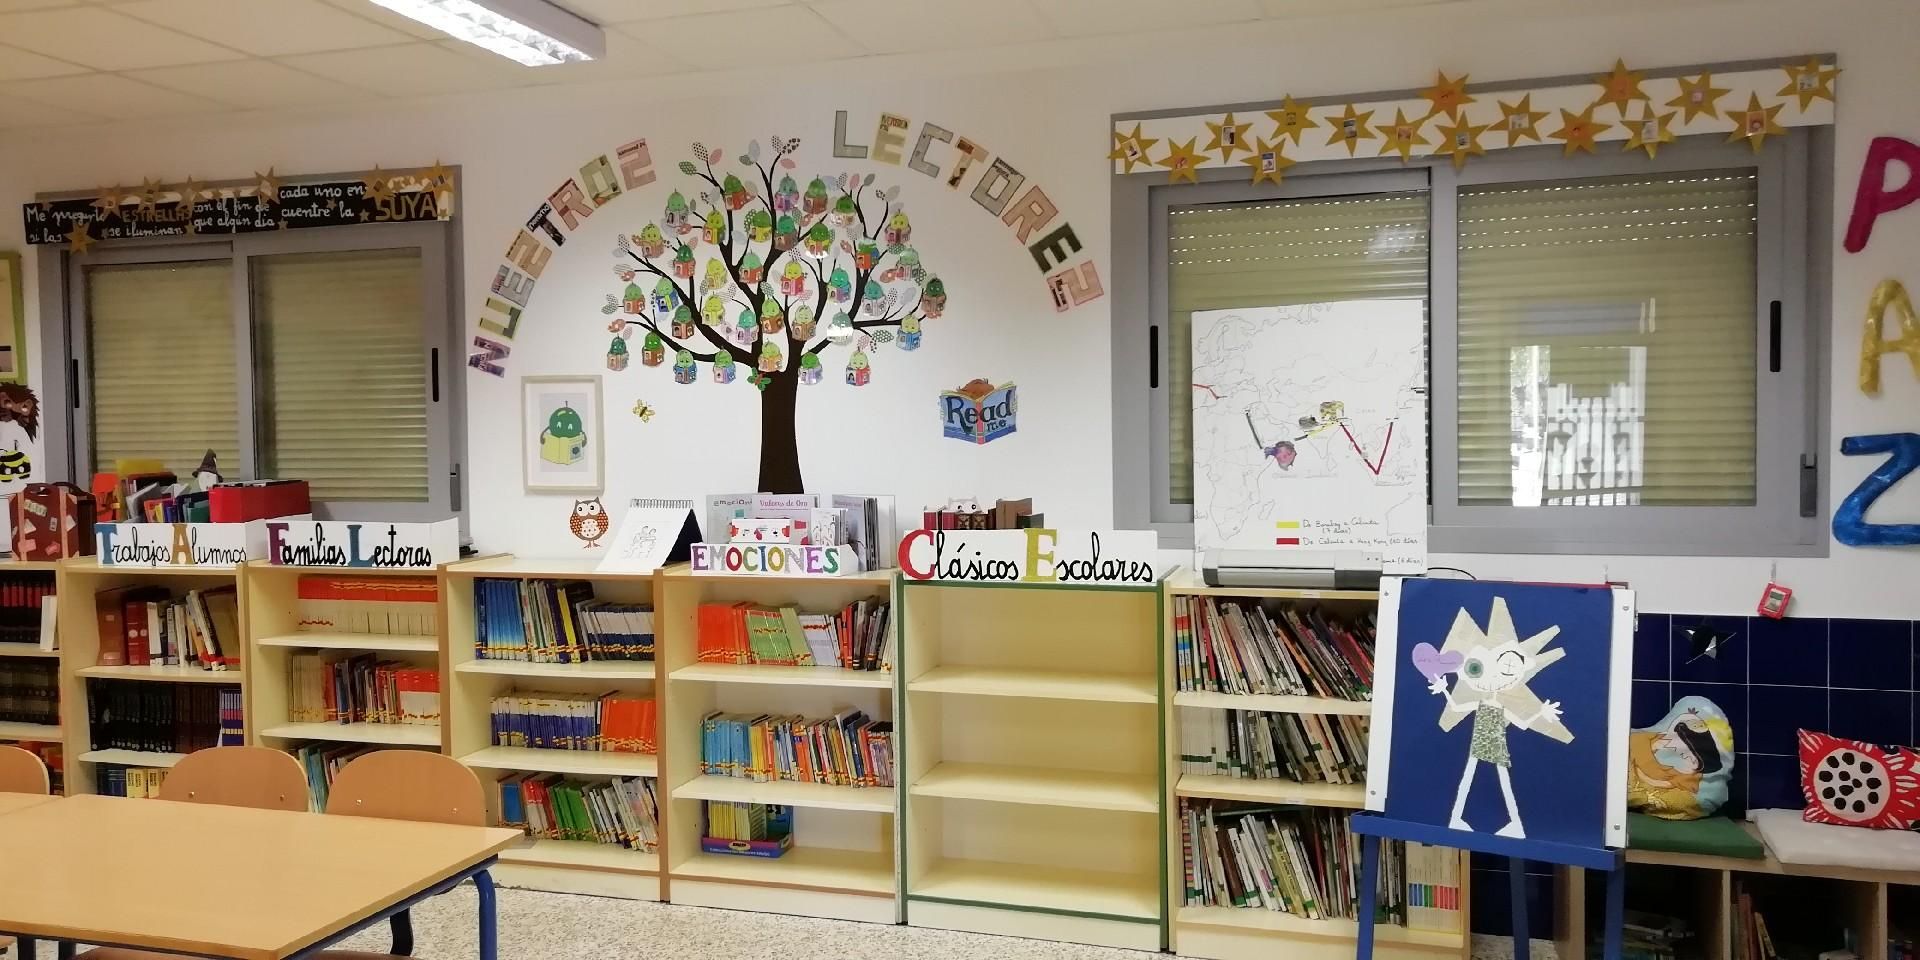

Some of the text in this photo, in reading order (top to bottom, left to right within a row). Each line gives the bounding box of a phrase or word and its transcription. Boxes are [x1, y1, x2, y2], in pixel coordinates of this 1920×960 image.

[280, 184, 308, 199] cada
[314, 186, 343, 198] uno
[26, 205, 47, 223] Me
[122, 208, 192, 223] ESTRELLAS
[193, 203, 213, 213] con
[233, 198, 252, 216] fin
[254, 196, 270, 212] de
[281, 202, 355, 218] cuentre la
[375, 193, 438, 221] SUYA
[126, 221, 184, 237] iluminan
[194, 216, 213, 232] que
[43, 228, 63, 243] las
[468, 110, 1104, 378] NUESTROS LECTORES
[945, 389, 1013, 435] Read
[986, 419, 1007, 432] me
[95, 523, 247, 567] Trabajos Alumnos
[266, 522, 432, 567] Familias Lectoras
[691, 545, 840, 574] EMOCIONES
[897, 528, 1153, 583] Clásicos Escolares
